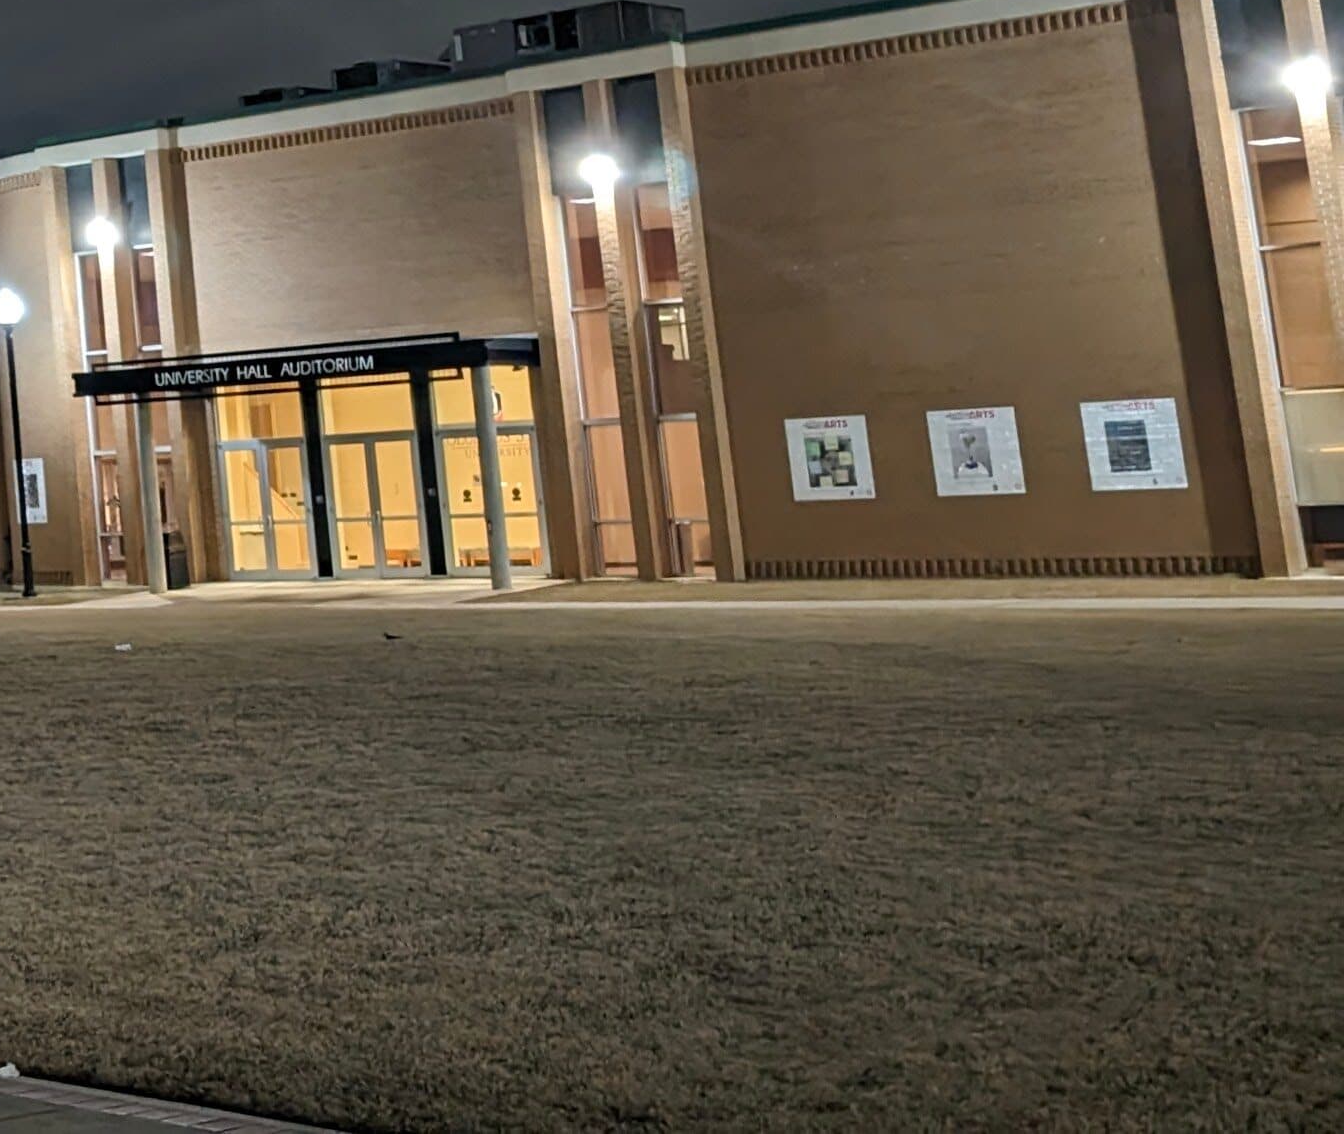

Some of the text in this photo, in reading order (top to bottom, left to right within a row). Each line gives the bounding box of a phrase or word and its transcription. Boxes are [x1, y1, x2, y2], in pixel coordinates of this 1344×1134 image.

[154, 355, 374, 387] UNIVERSITY HALL AUDITORIUM
[823, 419, 848, 428] ARTS
